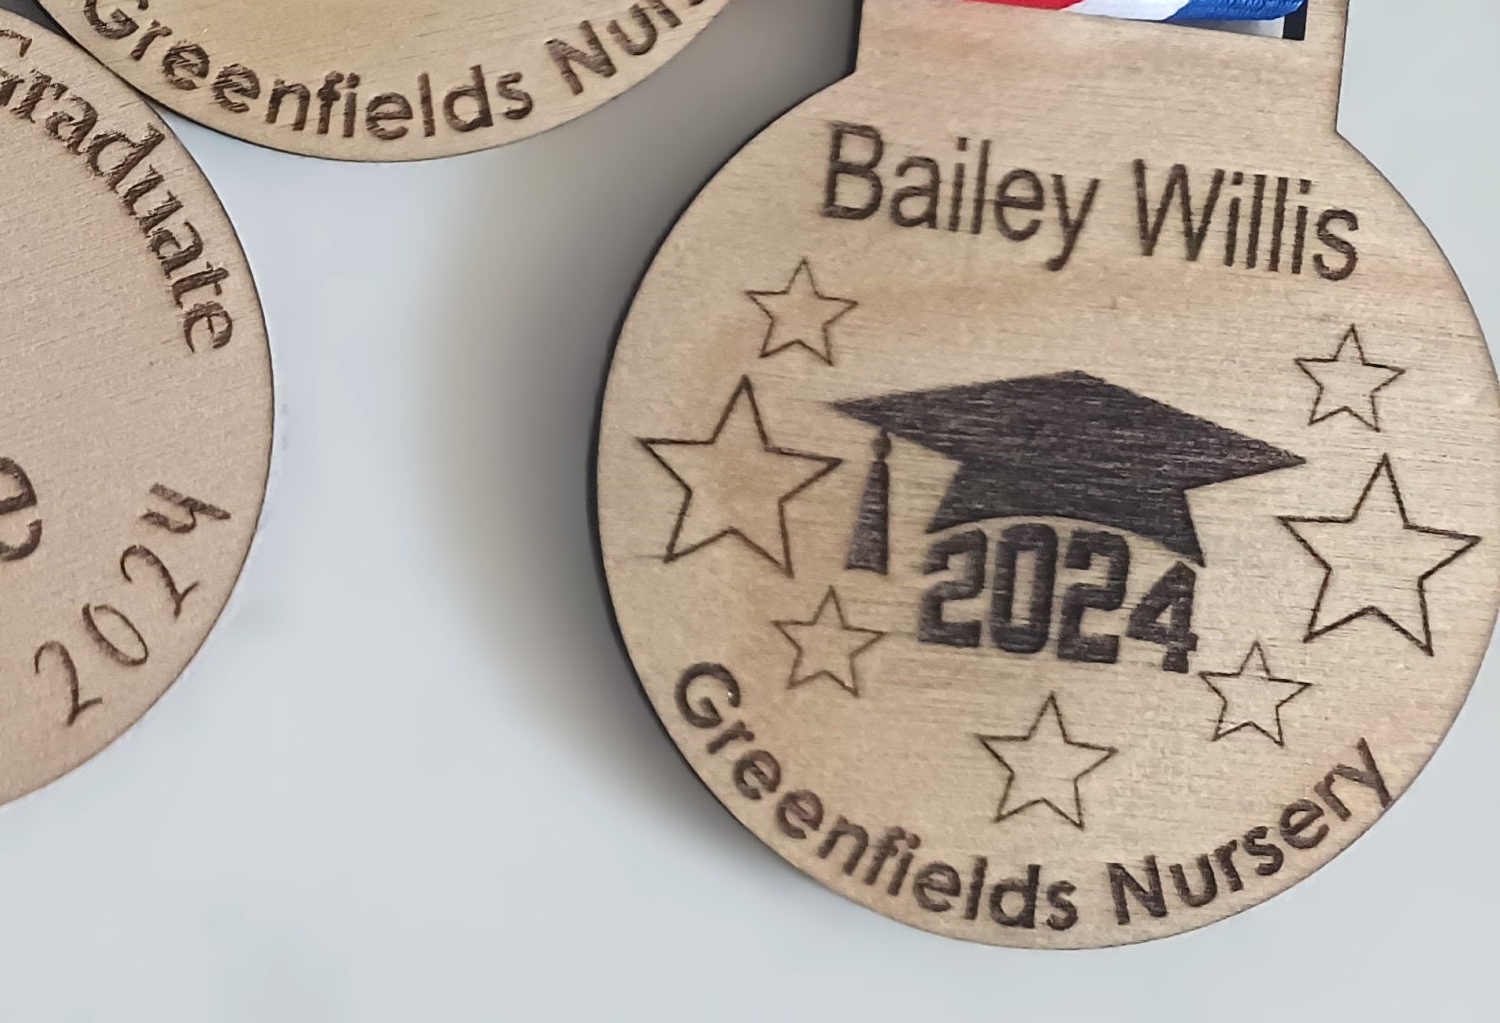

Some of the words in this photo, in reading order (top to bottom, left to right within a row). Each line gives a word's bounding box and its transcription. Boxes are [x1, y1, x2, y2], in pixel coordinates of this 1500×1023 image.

[821, 122, 1099, 273] Bailey
[1133, 158, 1360, 281] Willis
[33, 482, 232, 731] 2024
[918, 521, 1200, 674] 2024
[673, 661, 1079, 932] Greenfields
[1108, 736, 1397, 927] Nursery
